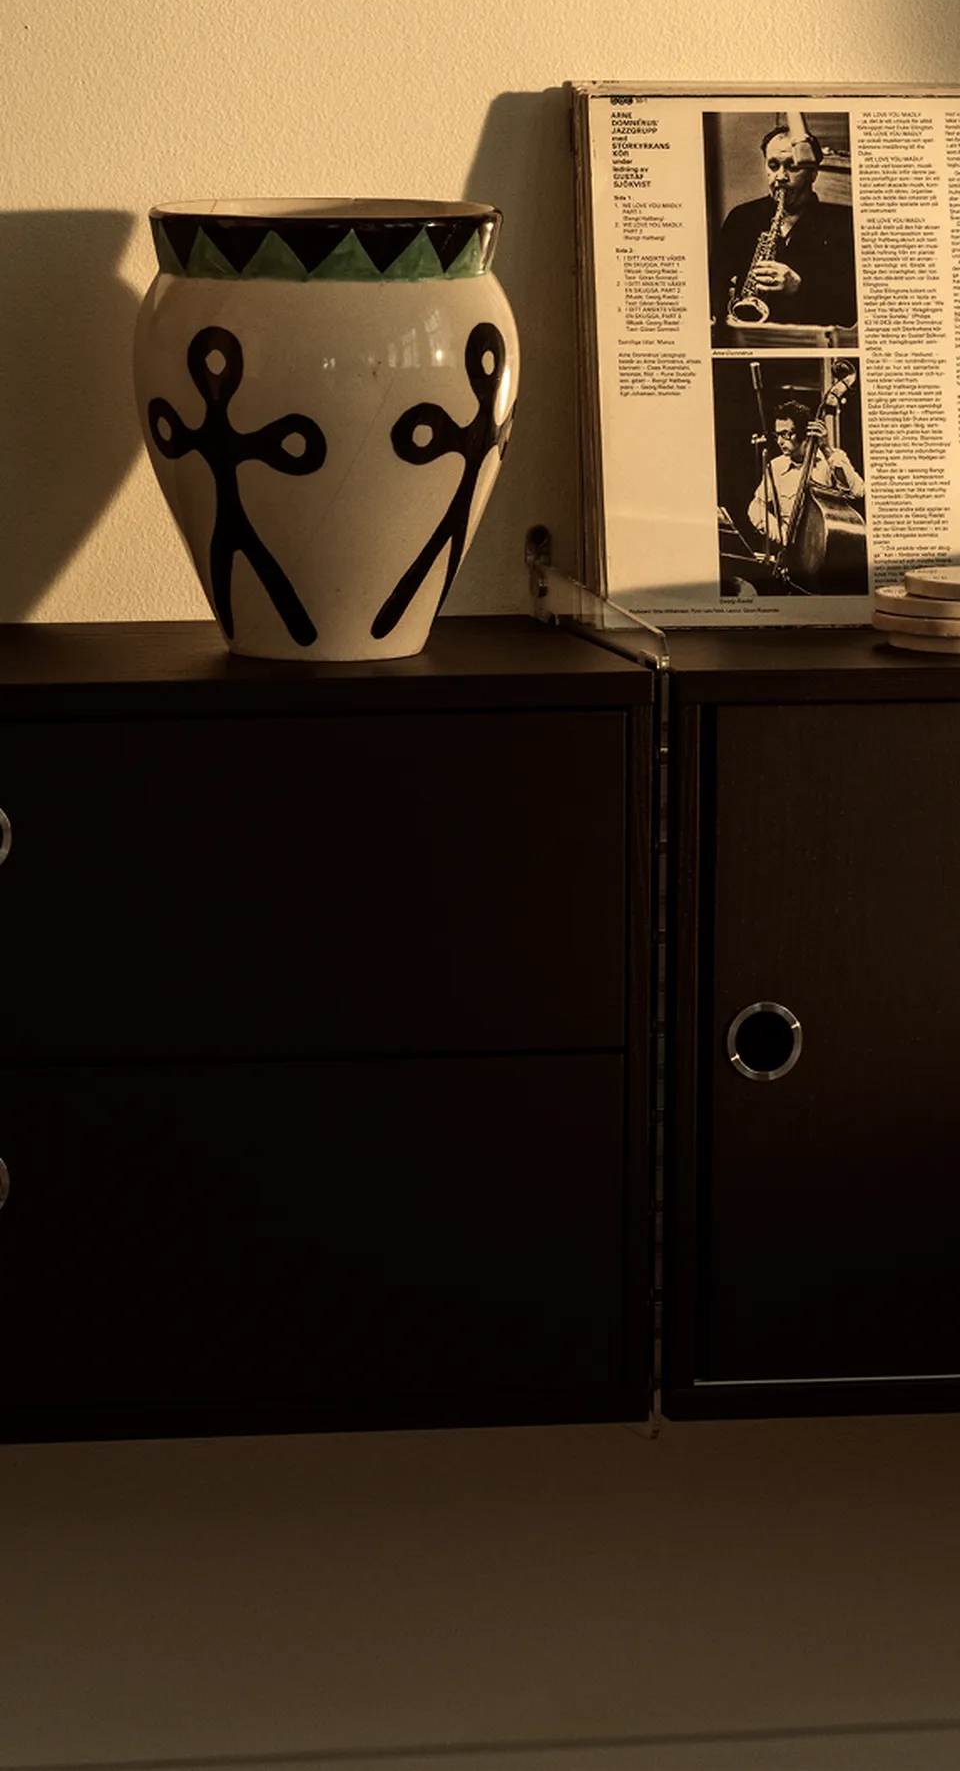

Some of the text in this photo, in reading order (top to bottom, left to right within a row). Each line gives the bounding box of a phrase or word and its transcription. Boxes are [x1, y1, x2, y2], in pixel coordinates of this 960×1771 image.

[611, 111, 633, 119] ARNE
[611, 127, 658, 135] JAZZGRUPP
[611, 142, 671, 150] STORKYRKANS
[613, 179, 651, 188] SJÖKVIST
